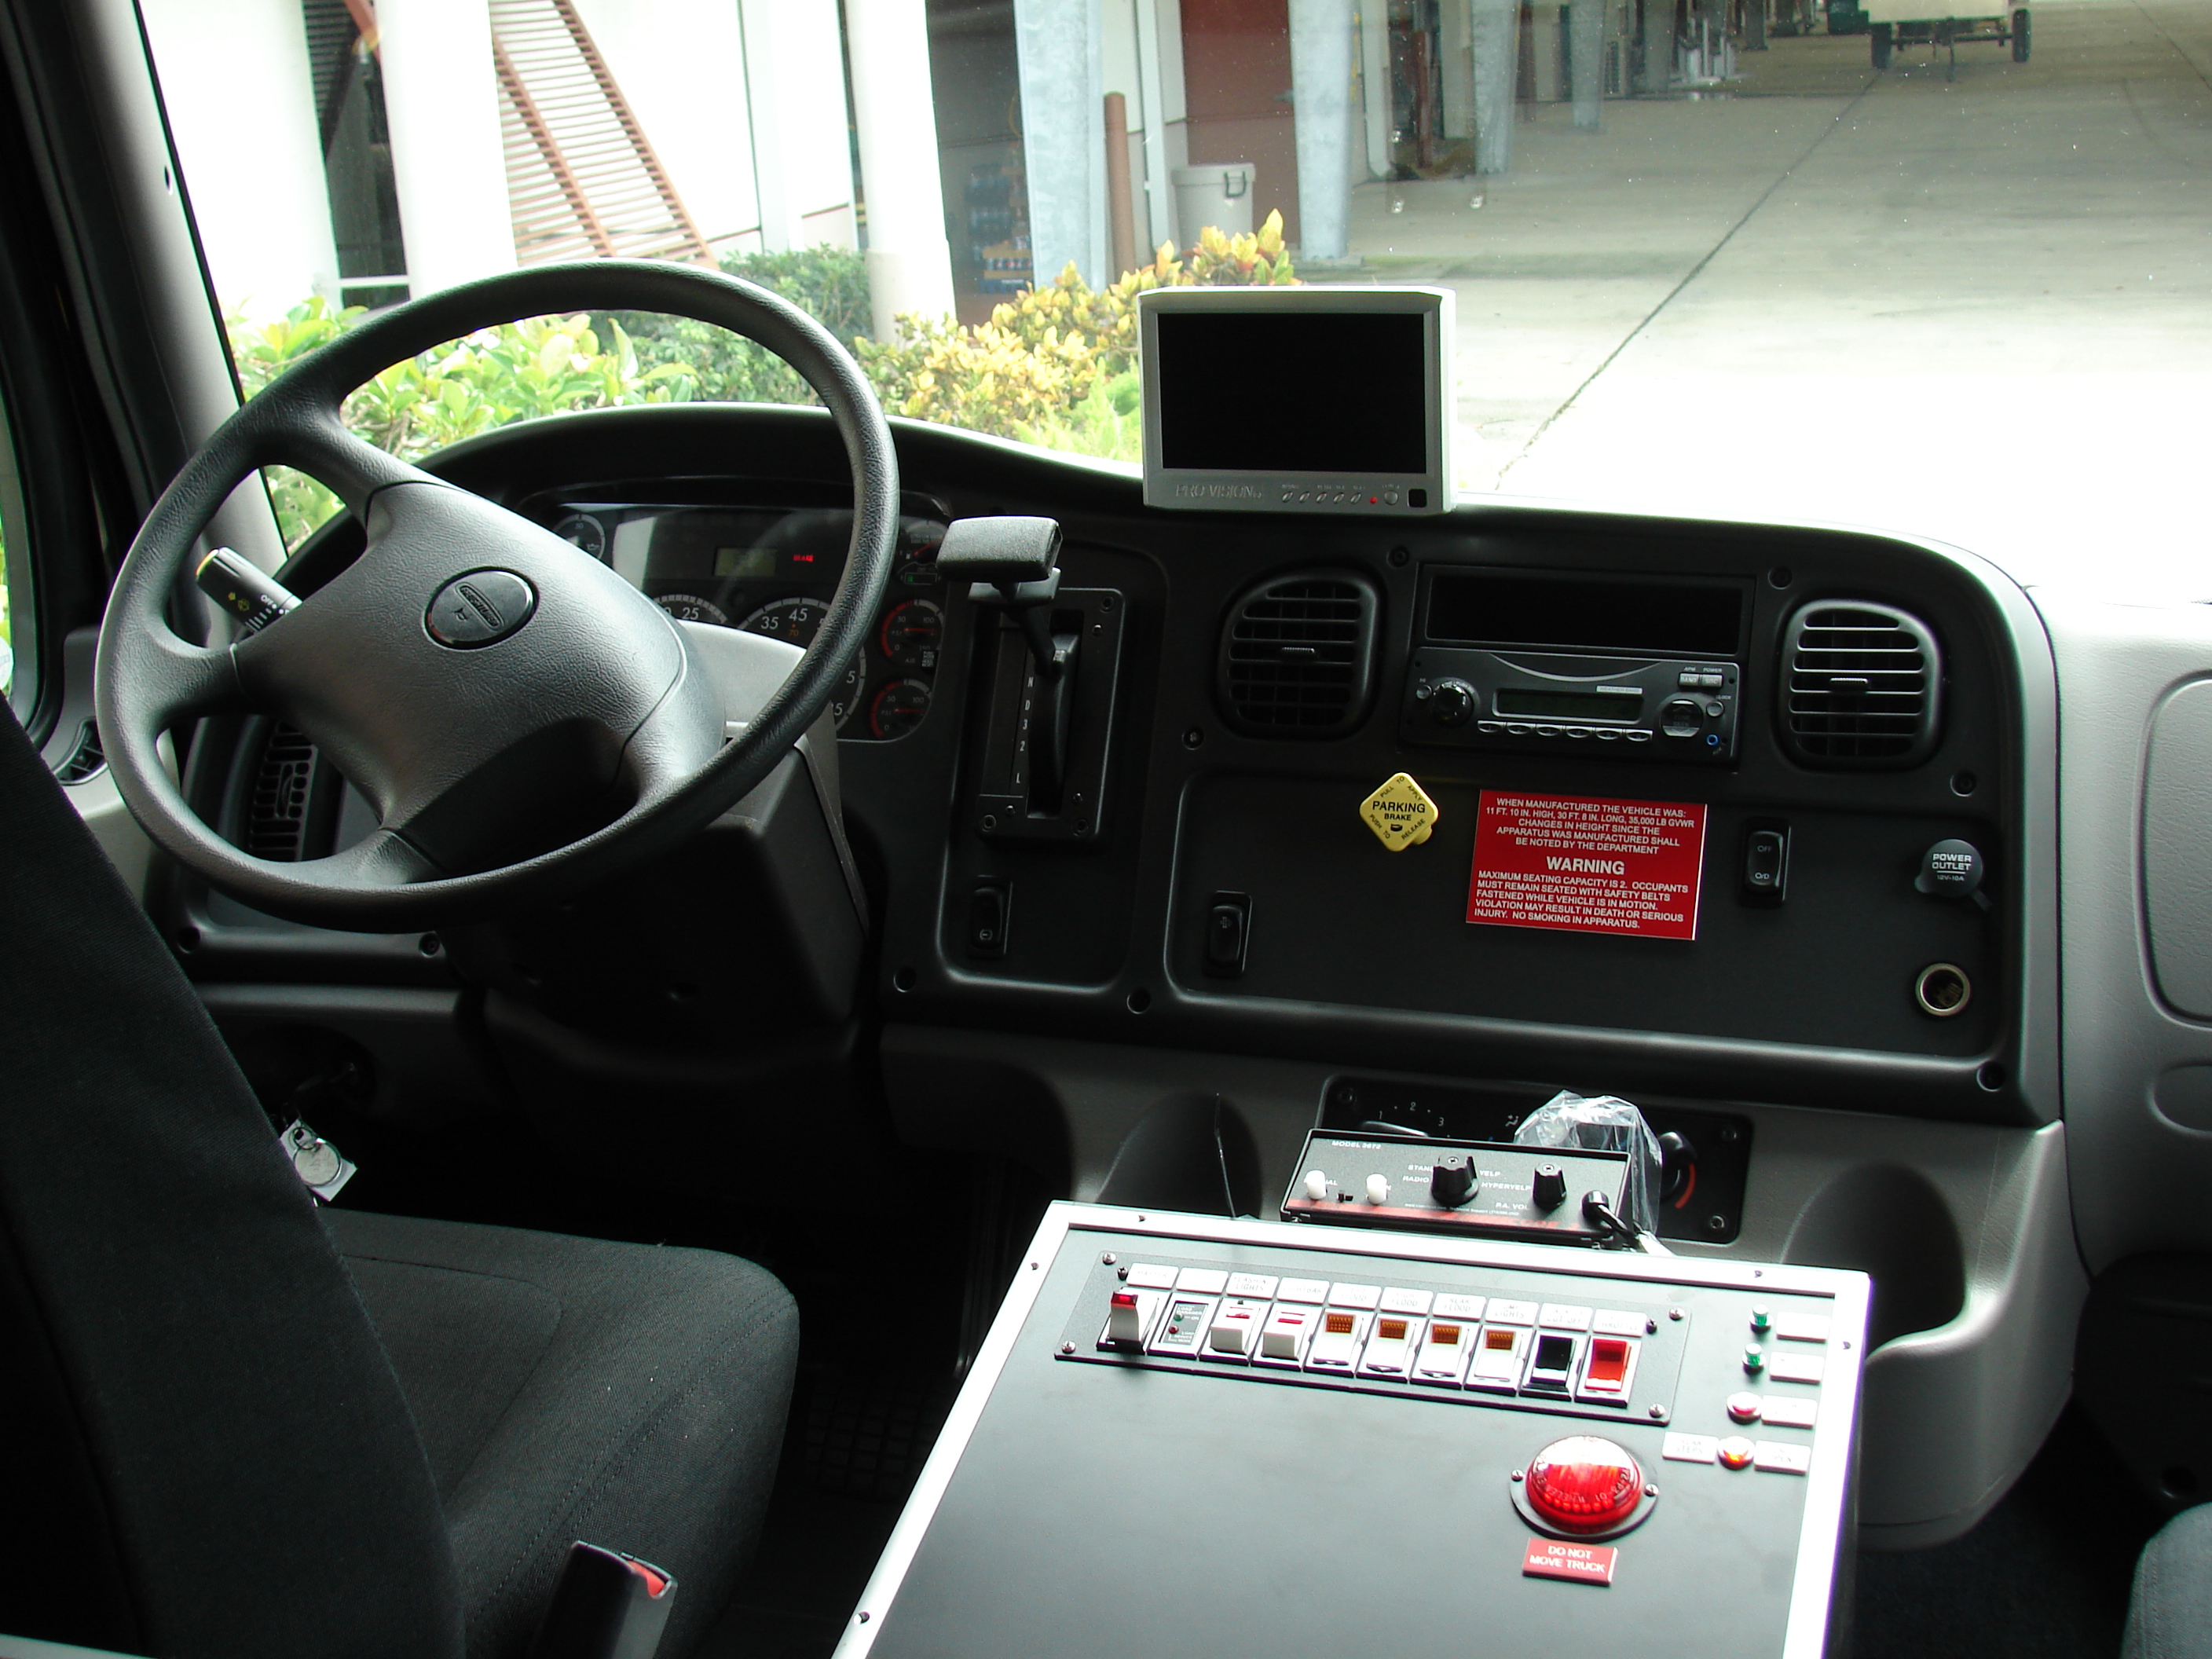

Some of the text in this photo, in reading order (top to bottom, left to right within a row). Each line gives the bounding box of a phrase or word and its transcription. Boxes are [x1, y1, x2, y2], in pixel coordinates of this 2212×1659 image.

[1210, 485, 1254, 499] VISION
[682, 607, 699, 621] 25
[789, 608, 808, 621] 45
[760, 616, 778, 629] 35
[1027, 676, 1034, 688] N
[1024, 700, 1031, 711] D
[1022, 719, 1028, 730] 3
[1020, 741, 1026, 751] 2
[1016, 772, 1020, 784] L
[1408, 786, 1422, 800] APPLY
[1372, 801, 1426, 813] PARKING
[1496, 797, 1686, 818] WHEN MANUFACTURED THE VEHICLE WAS:
[1520, 808, 1531, 817] IN.
[1533, 809, 1555, 819] HIGH,
[1601, 815, 1627, 824] LONG,
[1656, 818, 1666, 826] LB
[1668, 819, 1695, 828] GVWR
[1370, 814, 1382, 829] PUSH
[1401, 819, 1425, 840] RELEASE
[1518, 819, 1562, 829] CHANGES
[1576, 822, 1610, 832] HEIGHT
[1612, 824, 1639, 833] SINCE
[1642, 826, 1661, 835] THE
[1496, 826, 1680, 847] APPARATUS WAS MANUFACTURED SHALL
[1515, 837, 1528, 845] BE
[1529, 838, 1562, 848] NOTED
[1577, 841, 1595, 850] THE
[1597, 842, 1659, 855] DEPARTMENT
[1932, 853, 1972, 862] POWER
[1546, 855, 1625, 875] WARNING
[1932, 861, 1972, 870] OUTLET
[1478, 870, 1521, 881] MAXIMUM
[1522, 873, 1562, 884] SEATING
[1562, 876, 1608, 887] CAPACITY
[1609, 879, 1618, 888] IS
[1632, 881, 1688, 893] OCCUPANTS
[1478, 880, 1671, 902] MUST REMAIN SEATED WITH SAFETY BELTS
[1476, 889, 1658, 910] FASTENED WHILE VEHICLE IS IN MOTION.
[1475, 899, 1683, 922] VIOLATION MAY RESULT IN DEATH OR SERIOUS
[1474, 908, 1640, 928] INJURY. NO SMOKING IN APPARATUS.
[1409, 1102, 1416, 1111] 2
[1379, 1111, 1382, 1119] 1
[1438, 1117, 1445, 1126] 3
[1481, 1181, 1532, 1191] HYPERYELP
[1547, 1545, 1593, 1559] DO NOT
[1529, 1555, 1606, 1573] MOVE TRUCK
